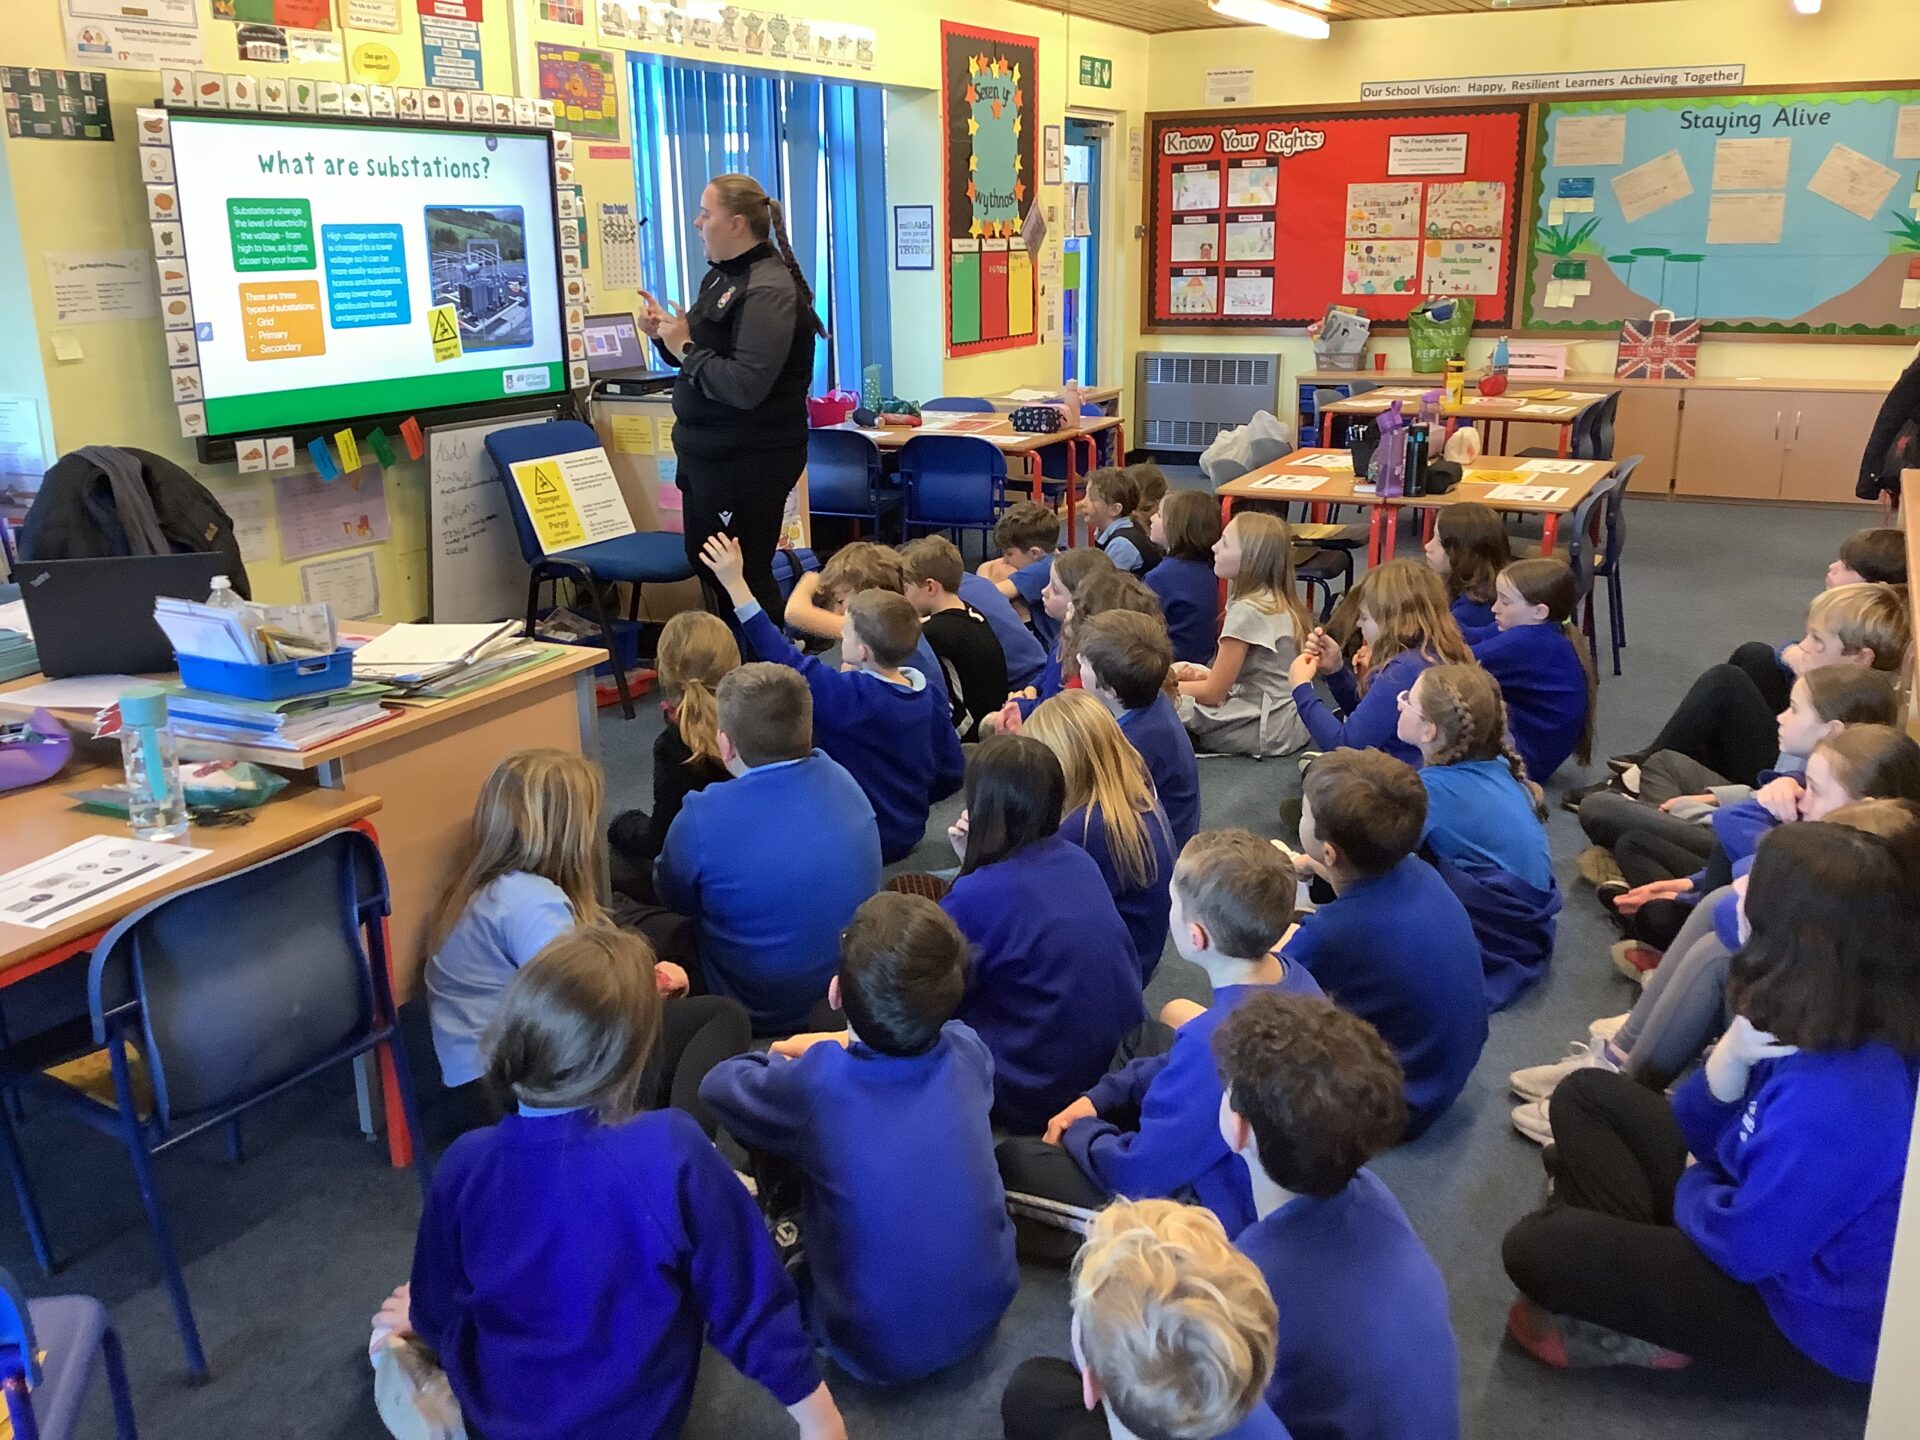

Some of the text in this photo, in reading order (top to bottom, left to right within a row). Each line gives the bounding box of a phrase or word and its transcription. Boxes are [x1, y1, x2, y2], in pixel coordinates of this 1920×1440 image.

[1081, 59, 1092, 71] FIRE
[1081, 73, 1091, 85] EXIT
[1363, 70, 1739, 98] Our School Vision: Happy, Resilient Learners Achieving Together
[975, 82, 1012, 107] Seren yr
[1680, 107, 1831, 135] Staying Alive
[1167, 129, 1323, 155] Know Your Rights!
[324, 156, 359, 177] are
[367, 155, 490, 179] substations?
[974, 187, 1015, 216] wythnos
[232, 206, 302, 217] Substations change
[235, 219, 307, 229] the level of electricity
[240, 232, 253, 240] the
[253, 232, 281, 242] voltage
[285, 231, 302, 240] from
[326, 231, 397, 241] High voltage electricity
[237, 244, 254, 254] high
[254, 244, 262, 253] to
[286, 243, 292, 252] it
[292, 243, 308, 254] gets
[899, 244, 931, 255] TRYING
[239, 255, 309, 266] closer to your home.
[245, 291, 297, 302] There are three
[246, 303, 317, 315] types of substations:
[256, 317, 275, 327] Grid
[258, 330, 288, 341] Primary
[1440, 326, 1467, 337] SLEEP
[260, 343, 302, 354] Secondary
[1416, 348, 1455, 359] REPEAT
[536, 494, 561, 505] Danger
